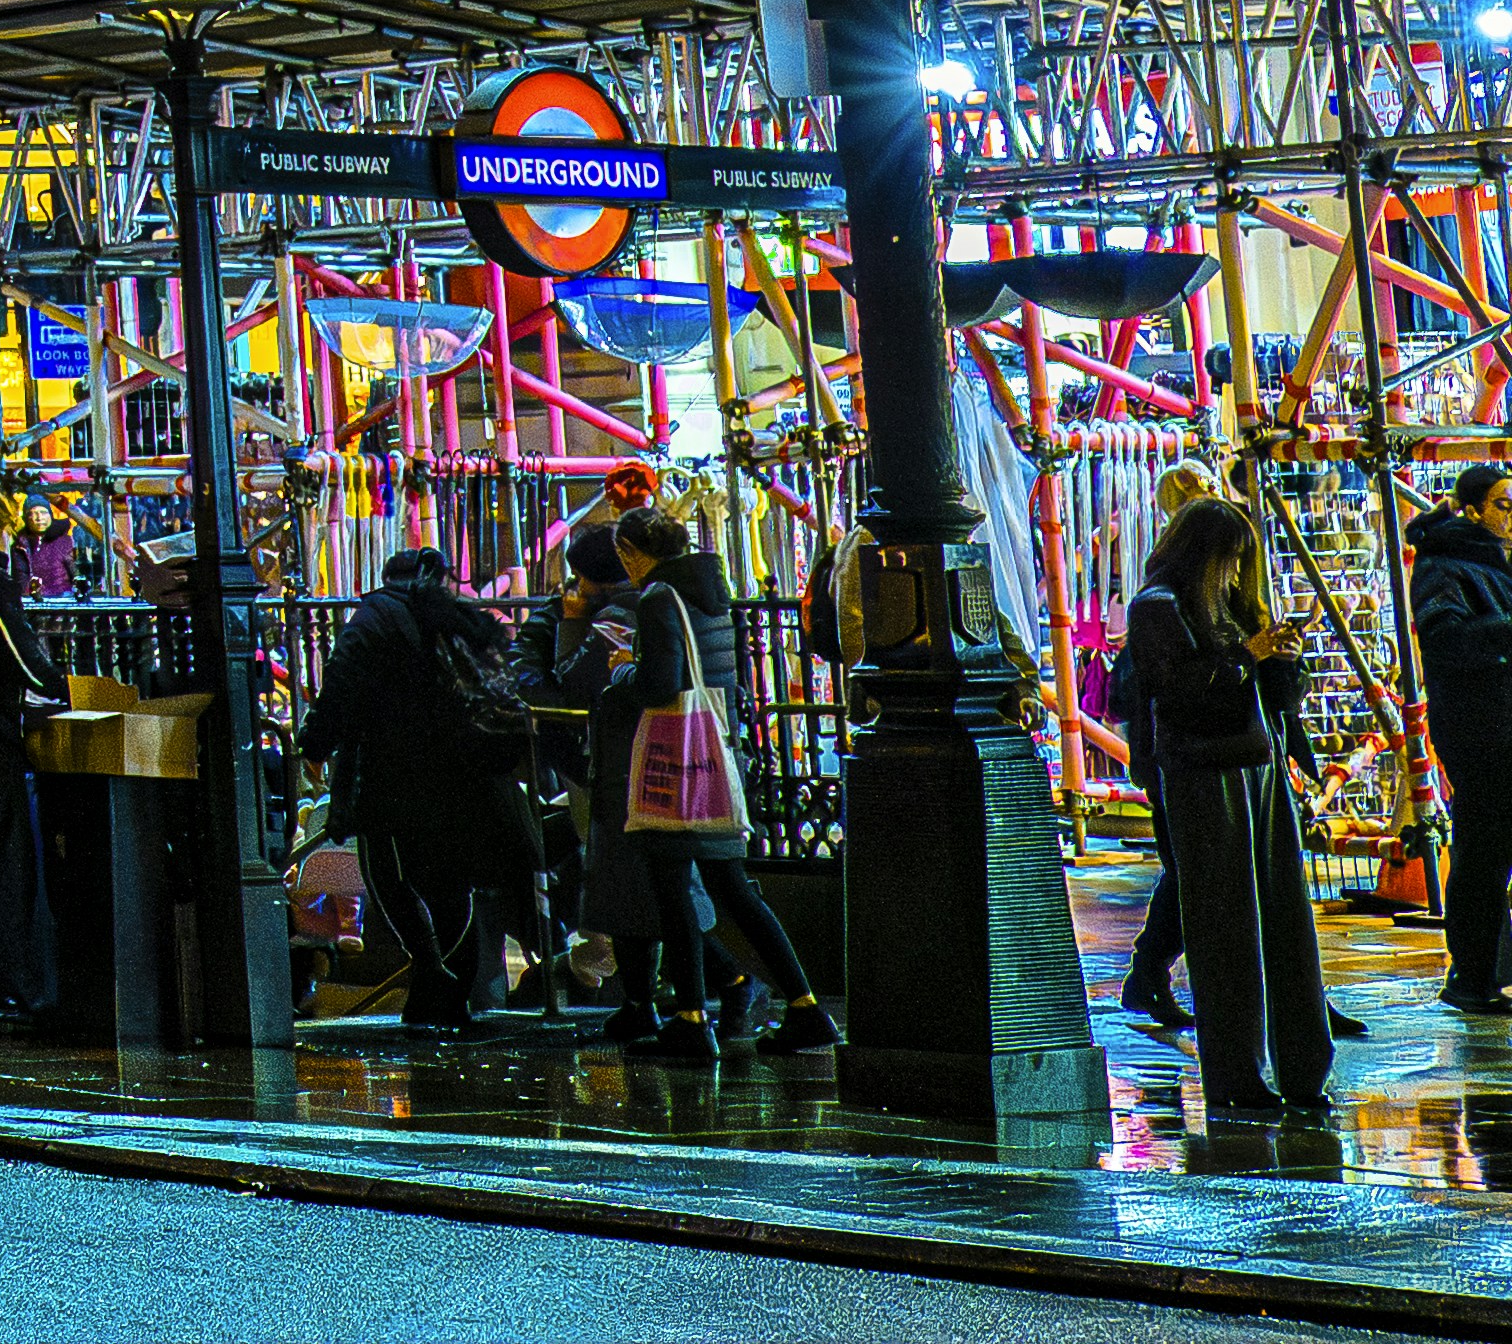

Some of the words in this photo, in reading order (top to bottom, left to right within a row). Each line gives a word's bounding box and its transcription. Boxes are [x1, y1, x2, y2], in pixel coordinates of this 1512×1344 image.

[260, 152, 320, 175] PUBLIC
[323, 154, 391, 177] SUBWAY
[462, 155, 660, 189] UNDERGROUND
[712, 168, 768, 188] PUBLIC
[771, 170, 833, 191] SUBWAY
[36, 350, 70, 361] LOOK
